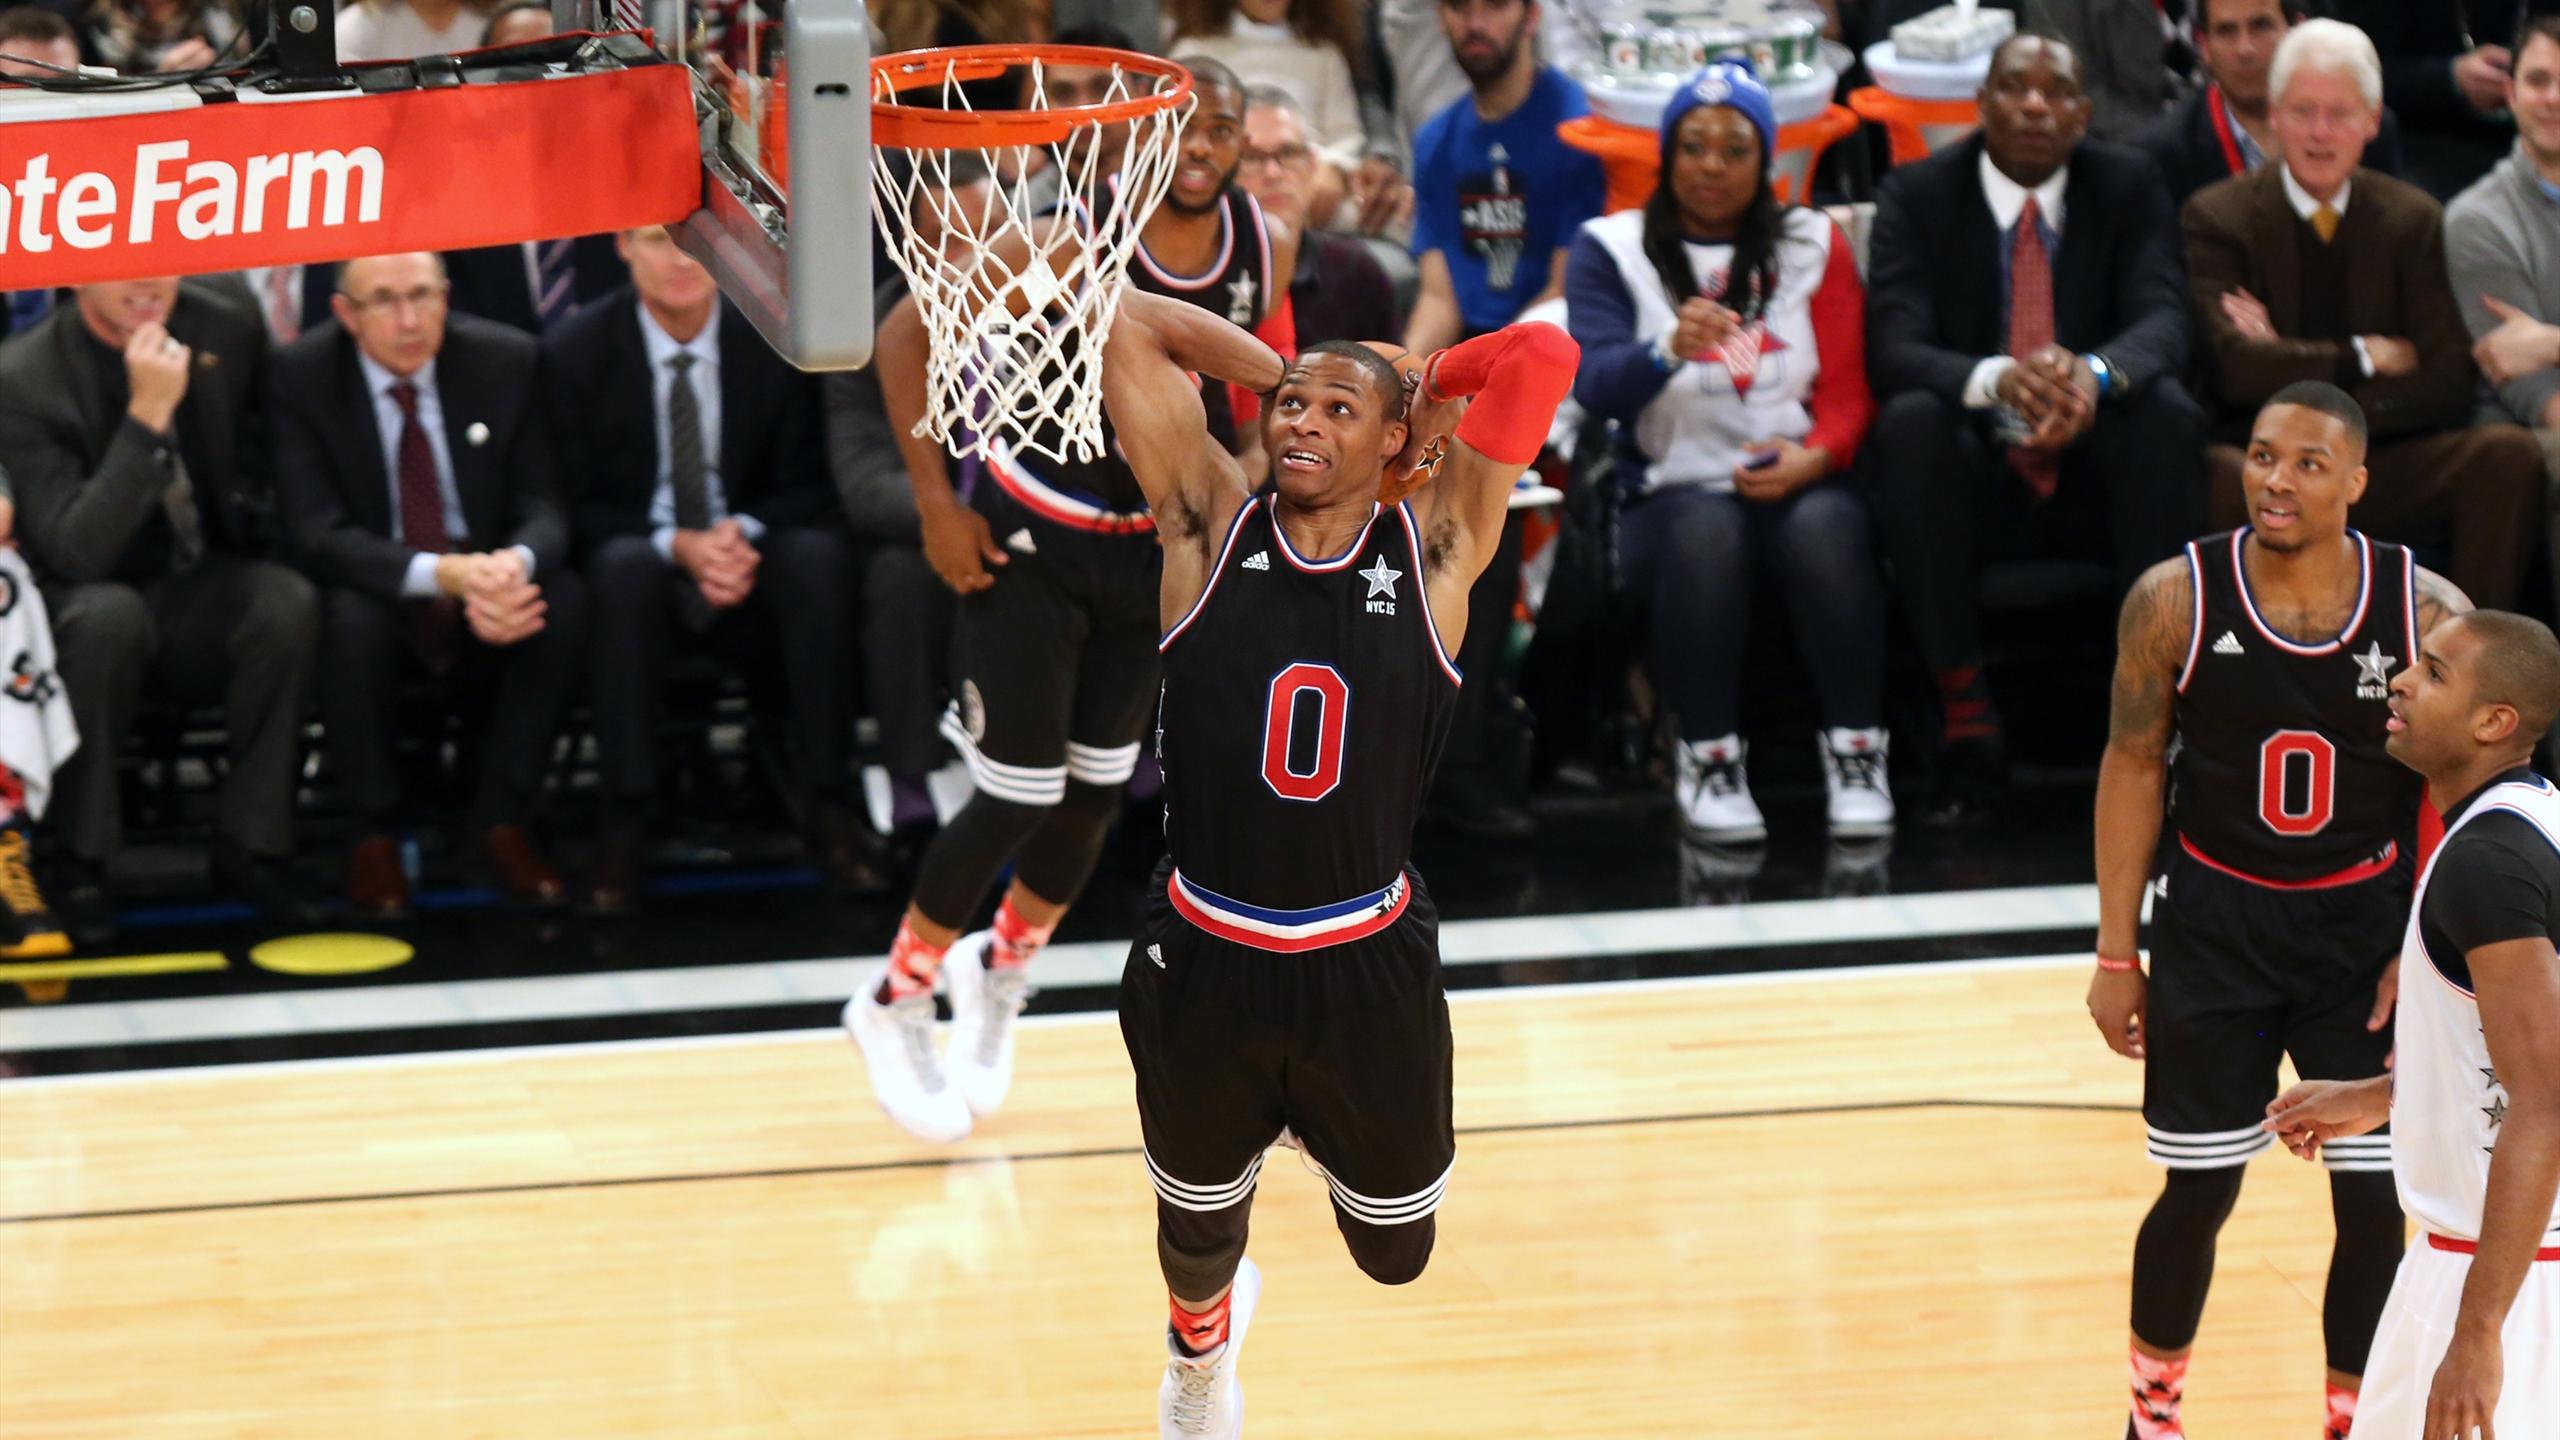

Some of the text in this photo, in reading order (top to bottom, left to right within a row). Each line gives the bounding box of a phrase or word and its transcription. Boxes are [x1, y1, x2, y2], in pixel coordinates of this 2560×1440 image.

[1366, 600, 1385, 614] NYC
[1261, 660, 1350, 803] 0
[2258, 729, 2336, 836] 0
